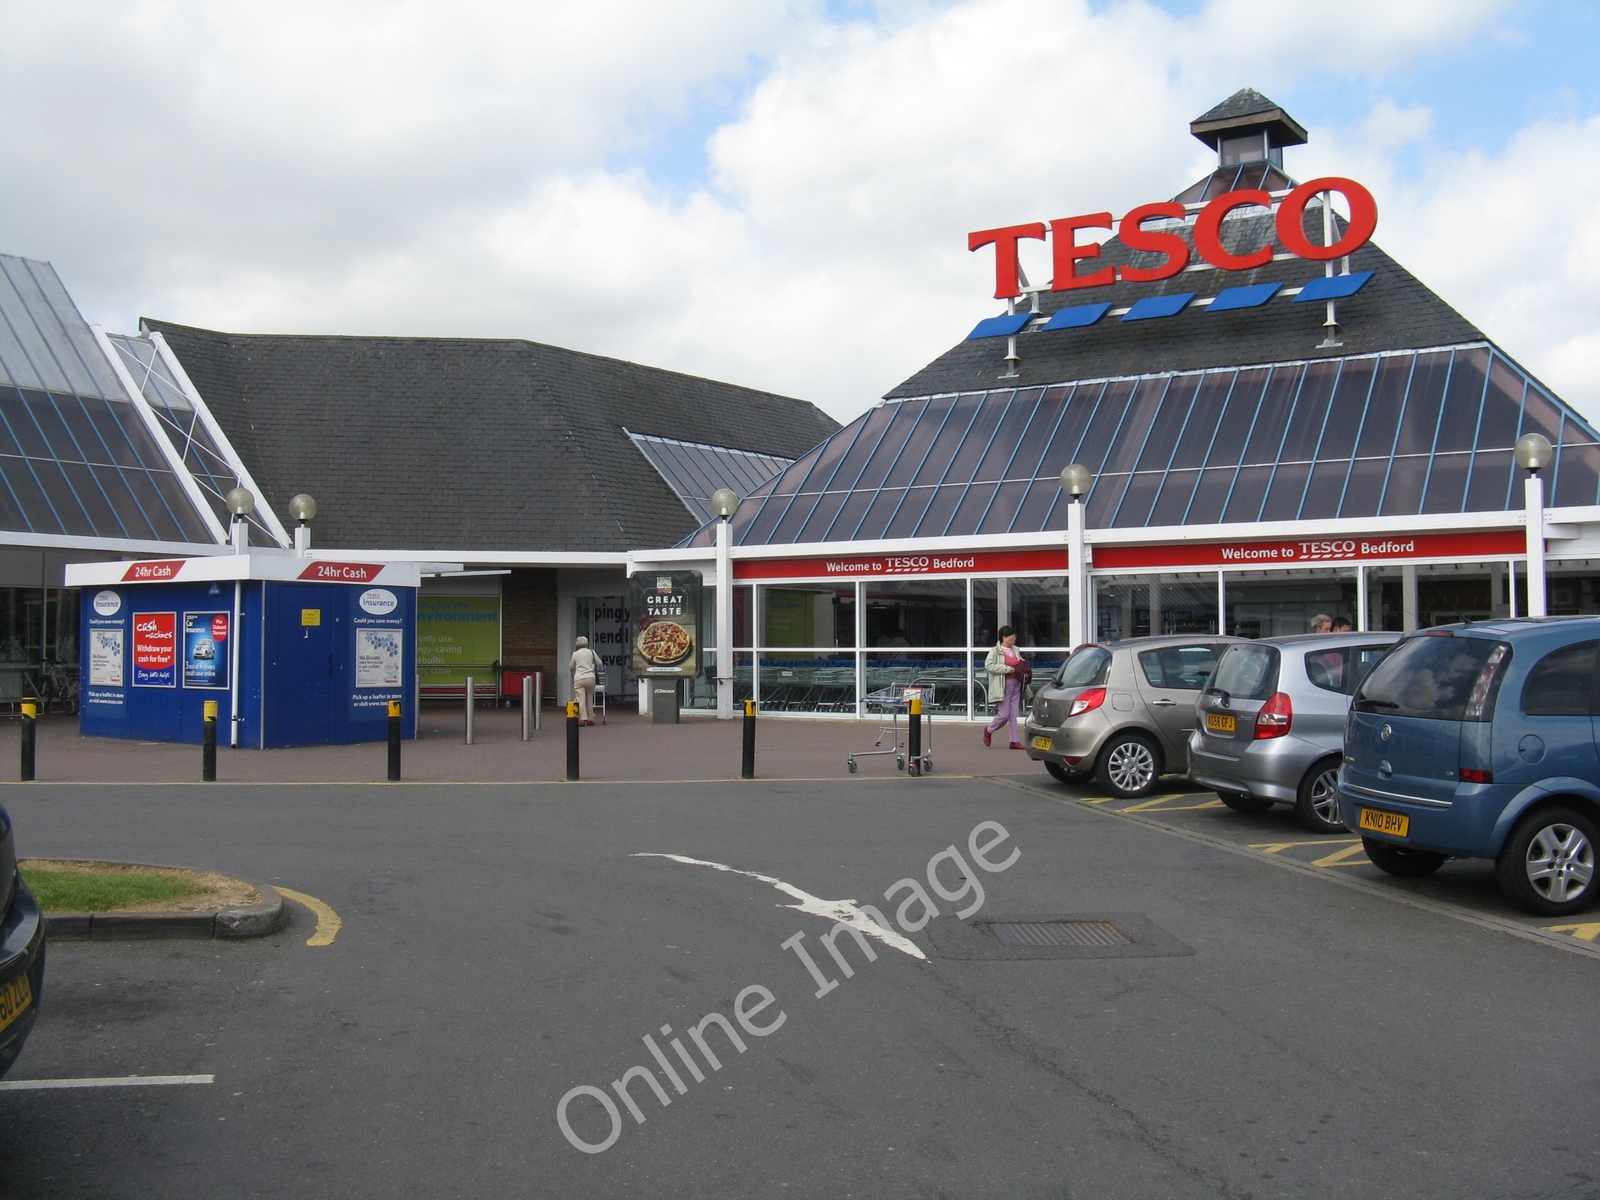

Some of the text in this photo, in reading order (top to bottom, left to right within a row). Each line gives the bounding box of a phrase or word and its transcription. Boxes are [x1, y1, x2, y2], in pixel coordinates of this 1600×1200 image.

[967, 176, 1379, 300] TESCO
[1221, 540, 1415, 560] Welcome to TESCO Bedford
[826, 556, 975, 572] Welcome to TESCO Bedford
[135, 565, 171, 578] 24hr Cash
[318, 566, 367, 580] 24hr Cash
[96, 600, 119, 608] Insurance
[363, 599, 395, 607] Insurance
[646, 595, 683, 604] GREAT
[417, 610, 498, 622] nvironment
[647, 607, 682, 616] TASTE
[136, 619, 157, 631] cash
[145, 630, 173, 639] machines
[418, 634, 437, 644] only
[160, 646, 172, 654] your
[417, 645, 463, 655] rgy-saving
[417, 656, 445, 664] tbulbs
[1365, 811, 1403, 832] KN10 BHV
